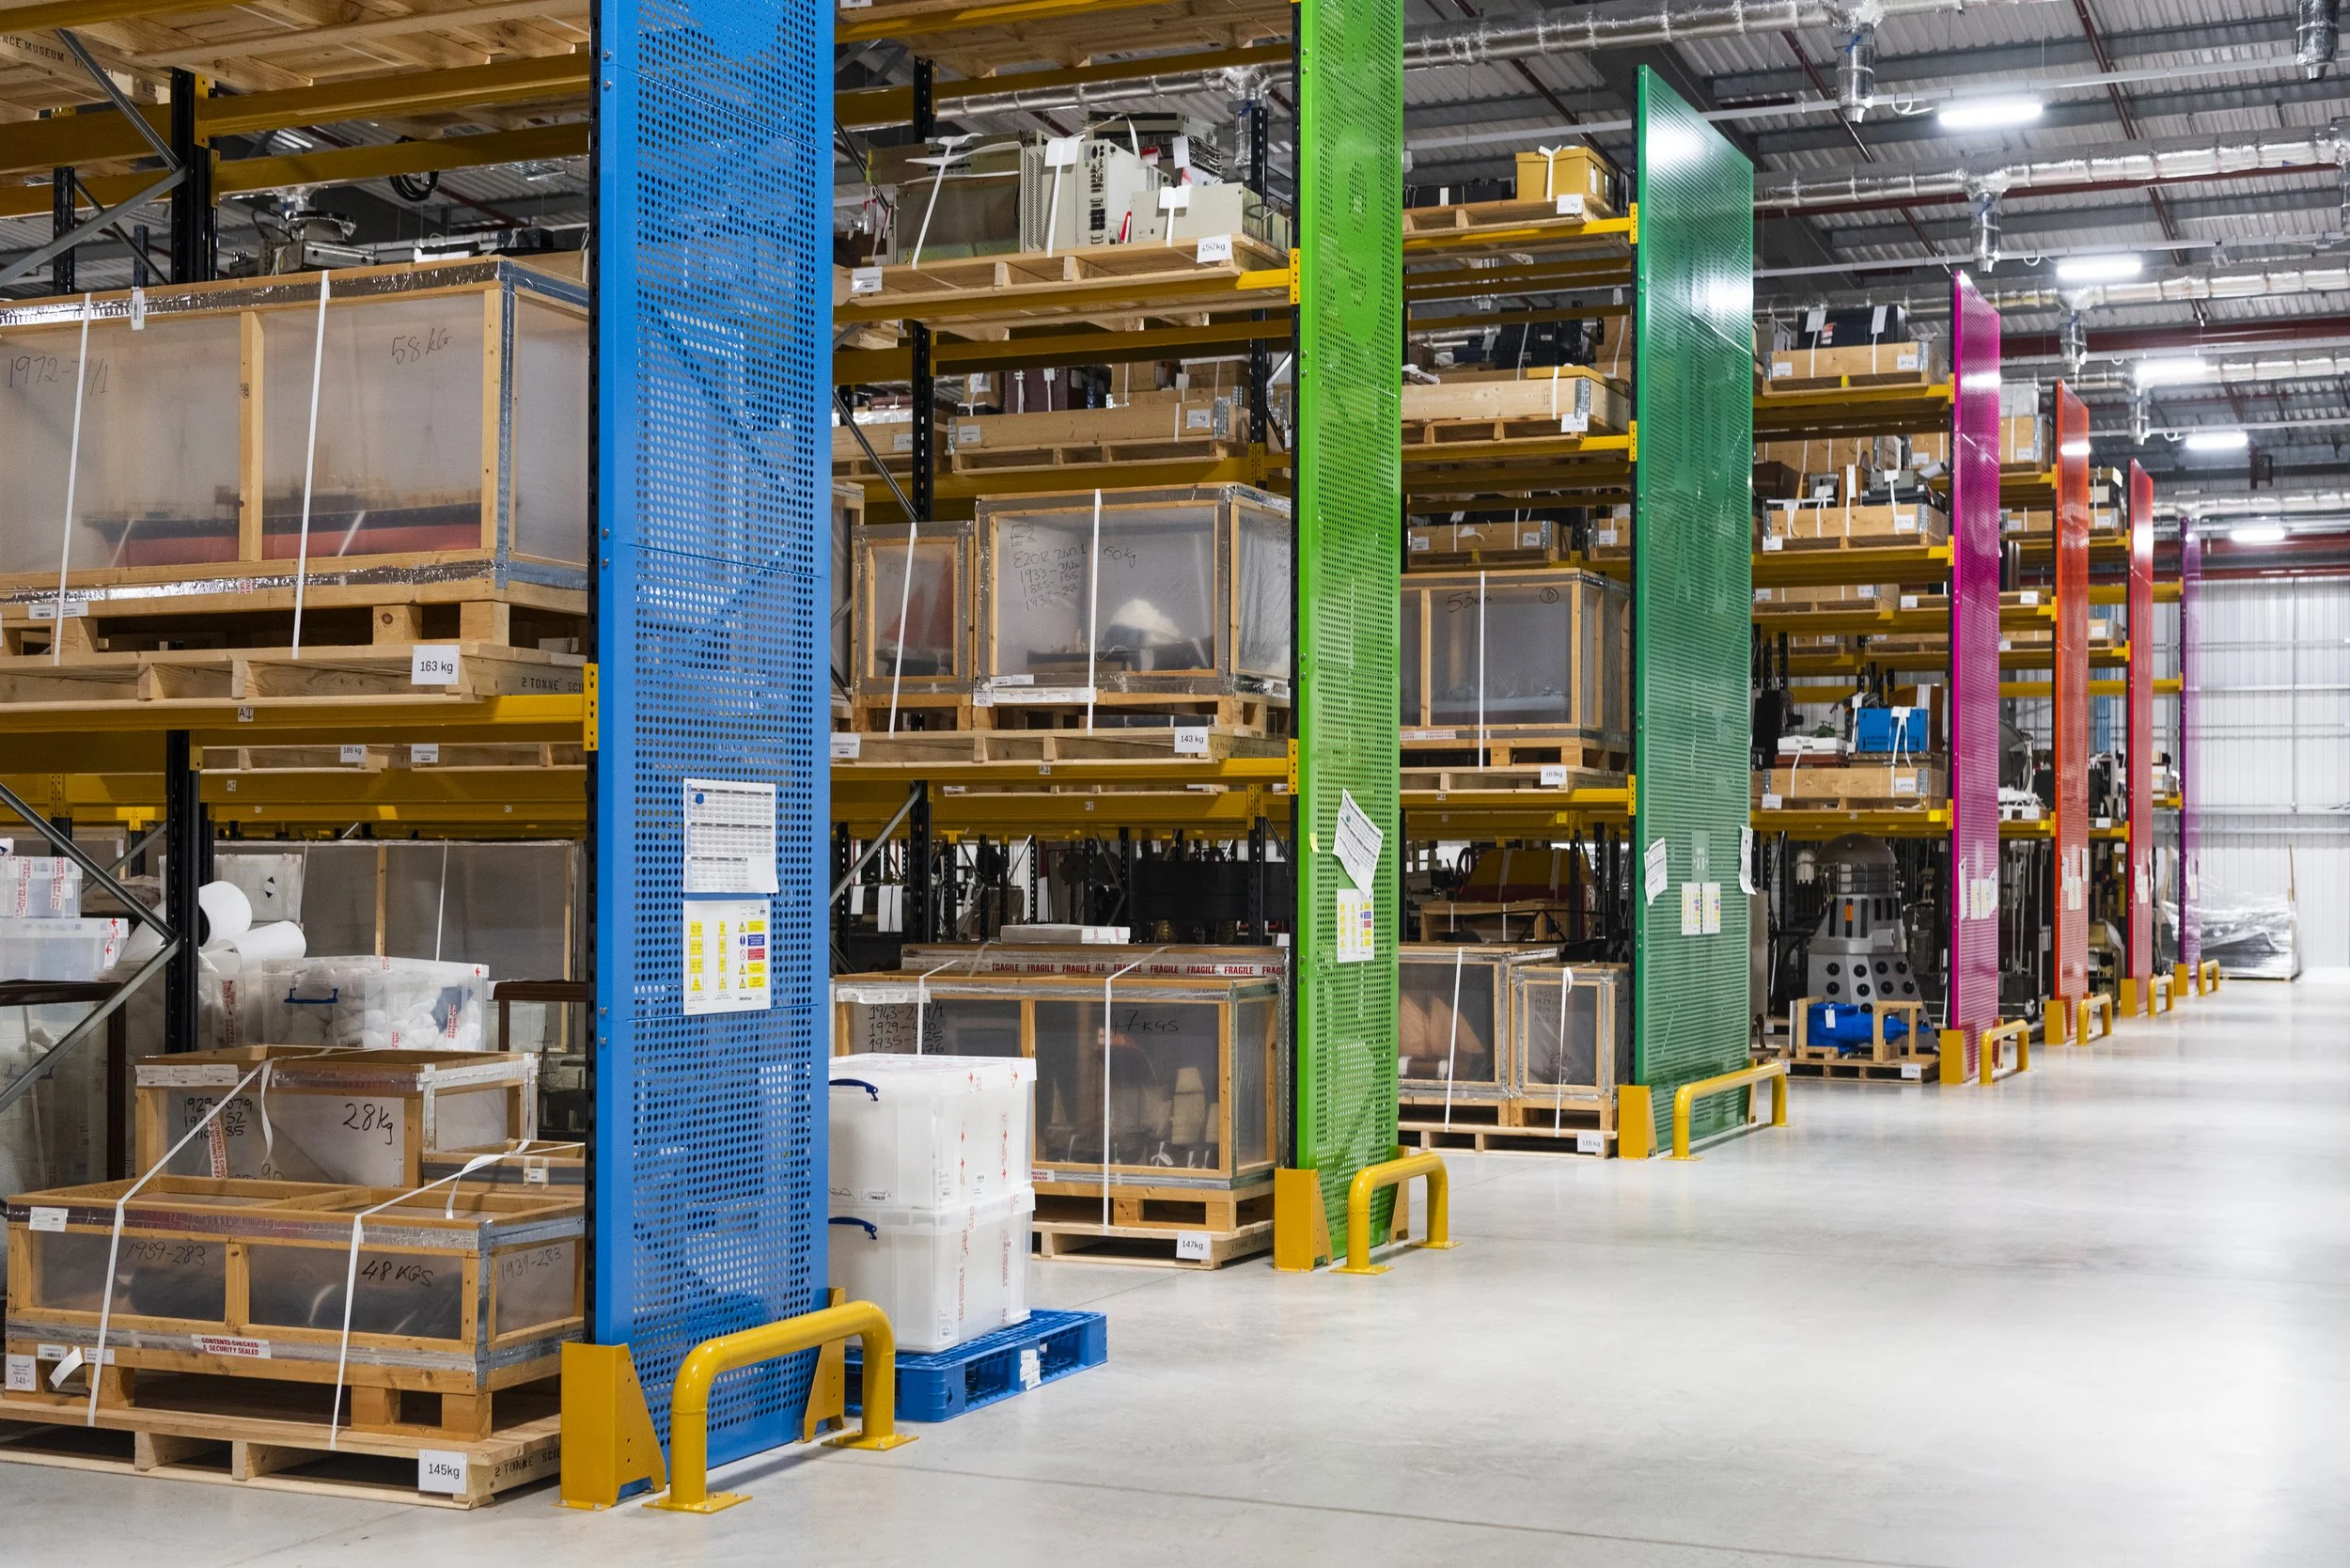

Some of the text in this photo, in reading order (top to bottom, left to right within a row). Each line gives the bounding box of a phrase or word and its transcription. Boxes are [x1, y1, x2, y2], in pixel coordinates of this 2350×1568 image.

[24, 41, 65, 62] MUSEUM
[419, 661, 453, 674] 163 kg
[521, 677, 527, 688] 2
[530, 678, 559, 691] TONNE
[1195, 735, 1204, 744] kg
[992, 963, 1019, 972] FRAGILE
[1026, 964, 1055, 973] FRAGILE
[1062, 964, 1090, 973] FRAGILE
[1150, 964, 1179, 974] FRAGILE
[1186, 965, 1215, 975] FRAGILE
[1224, 965, 1254, 975] FRAGILE
[214, 1121, 224, 1159] CONTENTS
[1182, 1240, 1203, 1250] 147kg
[361, 1260, 392, 1280] 48
[201, 1337, 259, 1348] CONTENTS CHECKED
[209, 1344, 237, 1354] SECURITY
[237, 1347, 259, 1356] SEALED
[428, 1463, 461, 1480] 145kg
[494, 1466, 501, 1477] 2
[504, 1456, 533, 1474] TONNE
